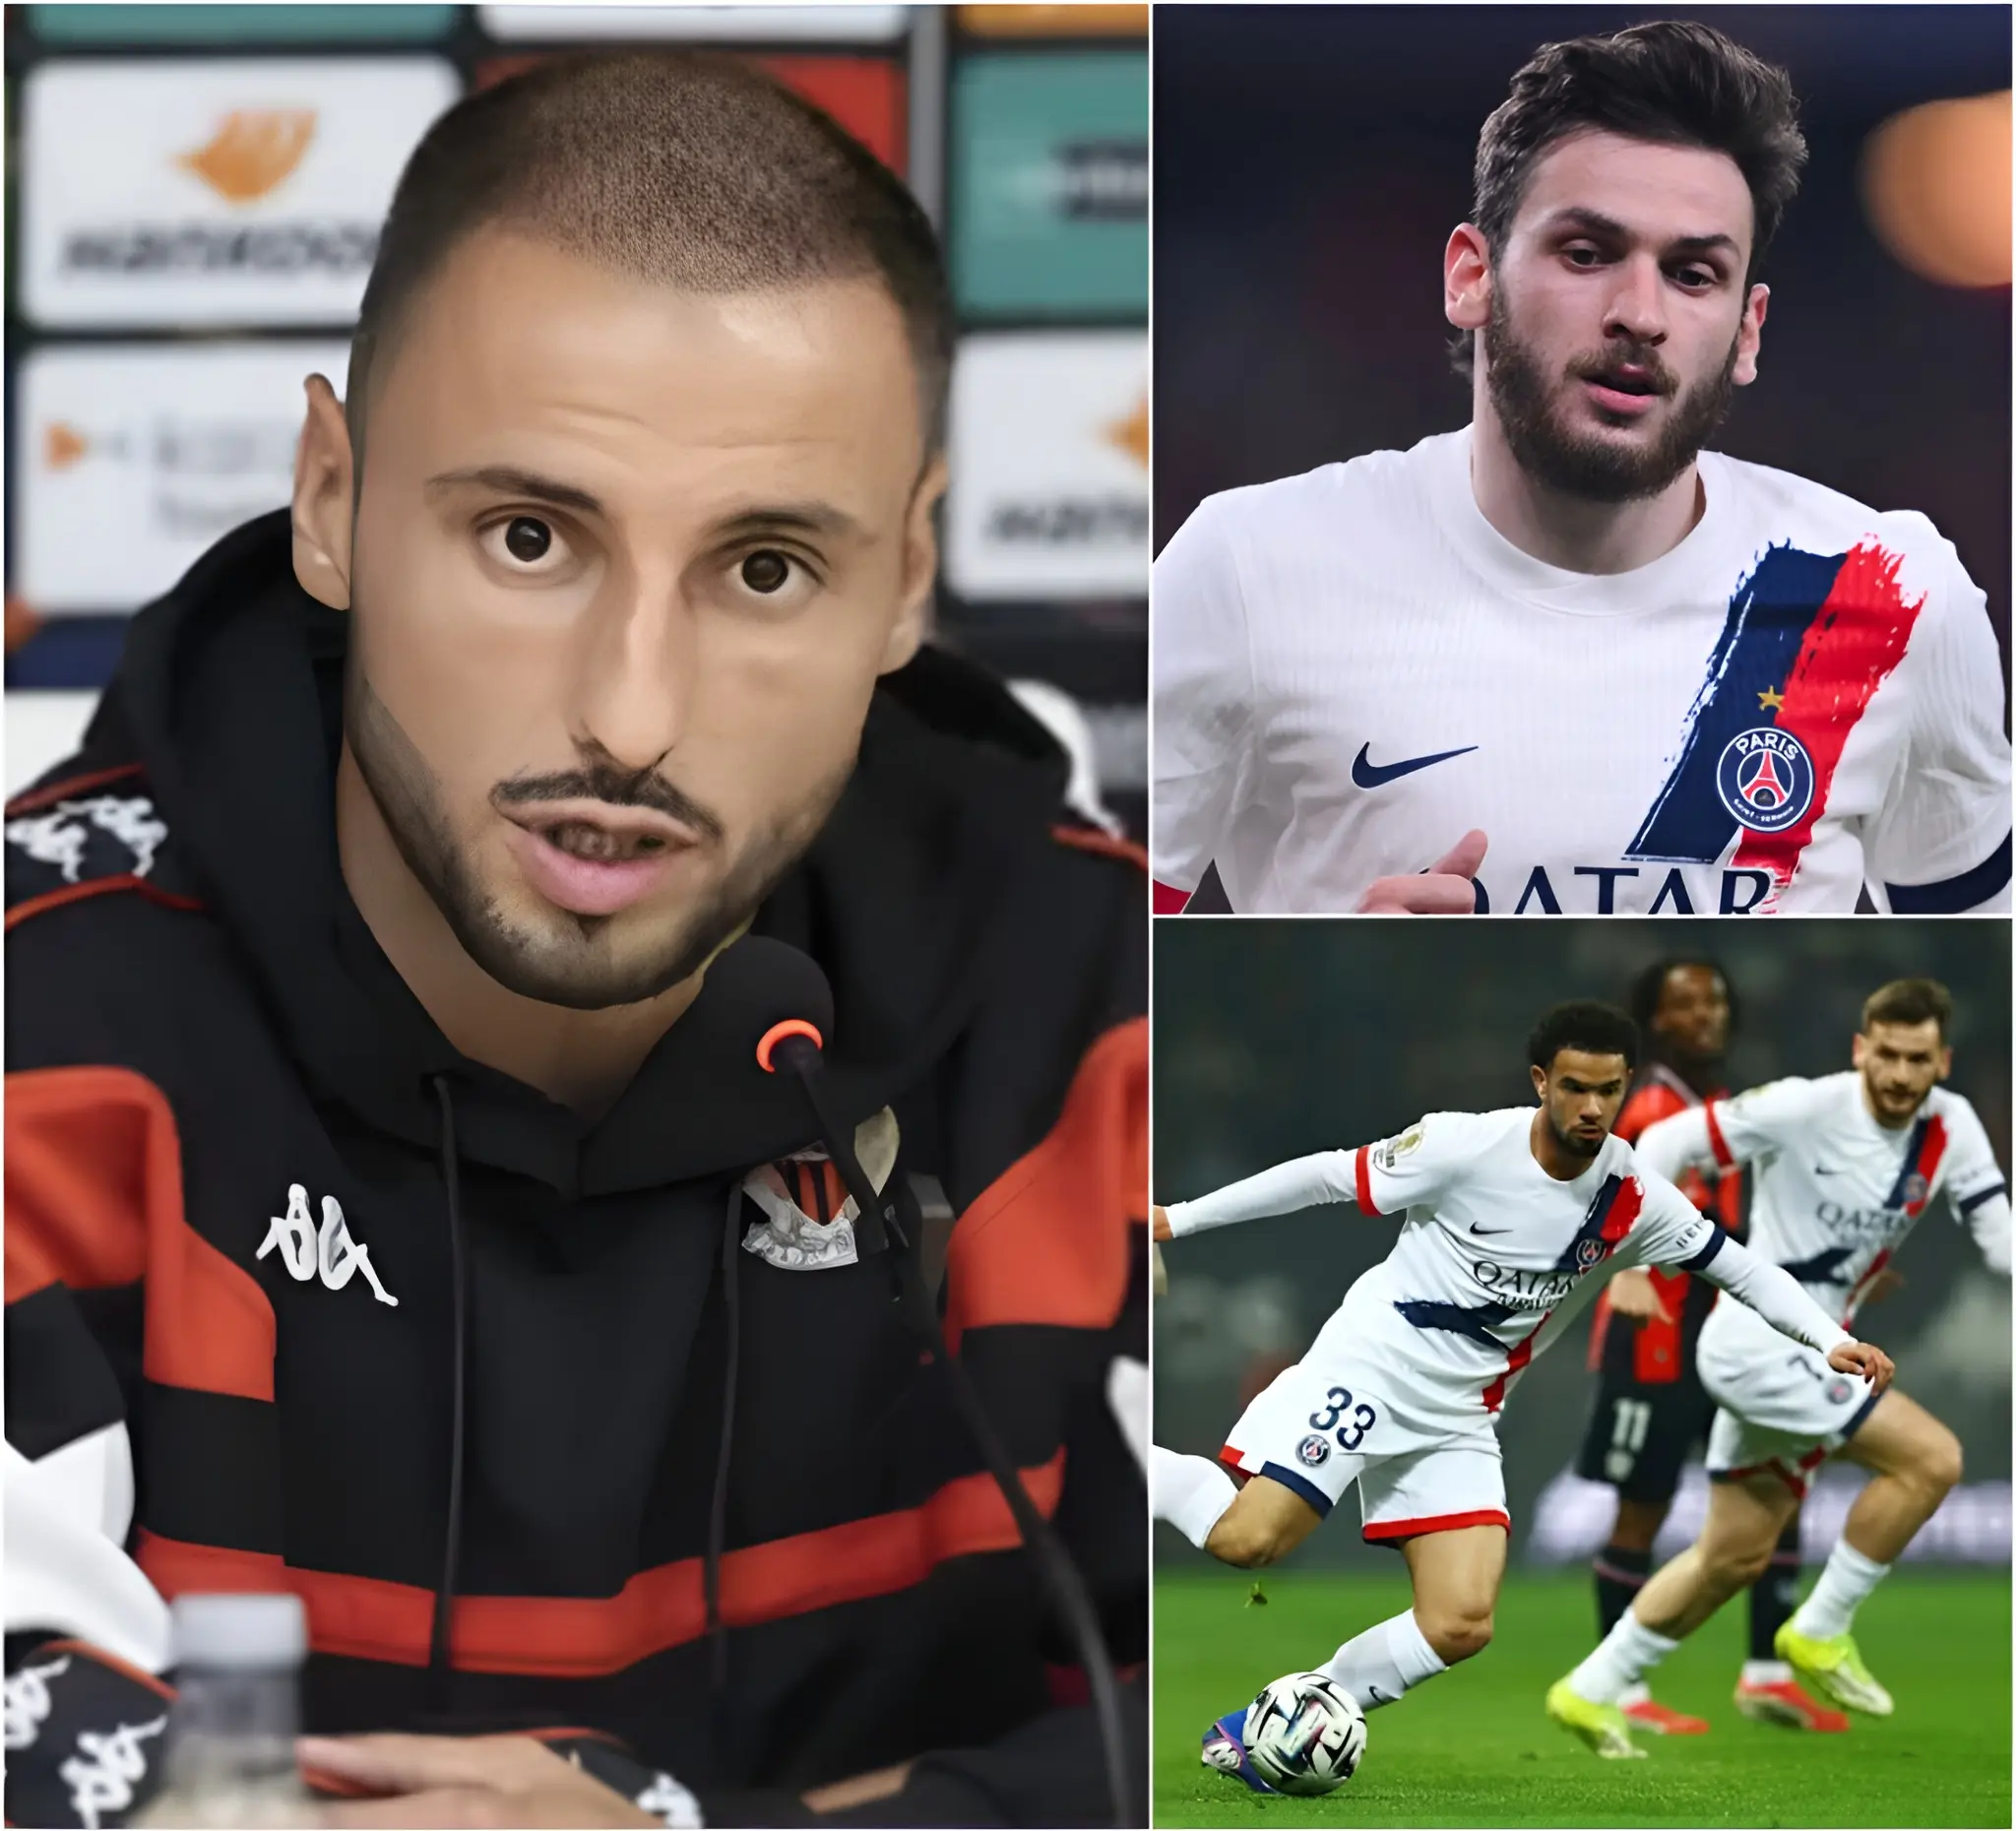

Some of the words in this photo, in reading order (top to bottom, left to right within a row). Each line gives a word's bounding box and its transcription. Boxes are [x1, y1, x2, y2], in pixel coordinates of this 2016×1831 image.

[1735, 732, 1799, 761] PARIS
[1308, 1385, 1377, 1452] 33
[1611, 1397, 1653, 1453] 11
